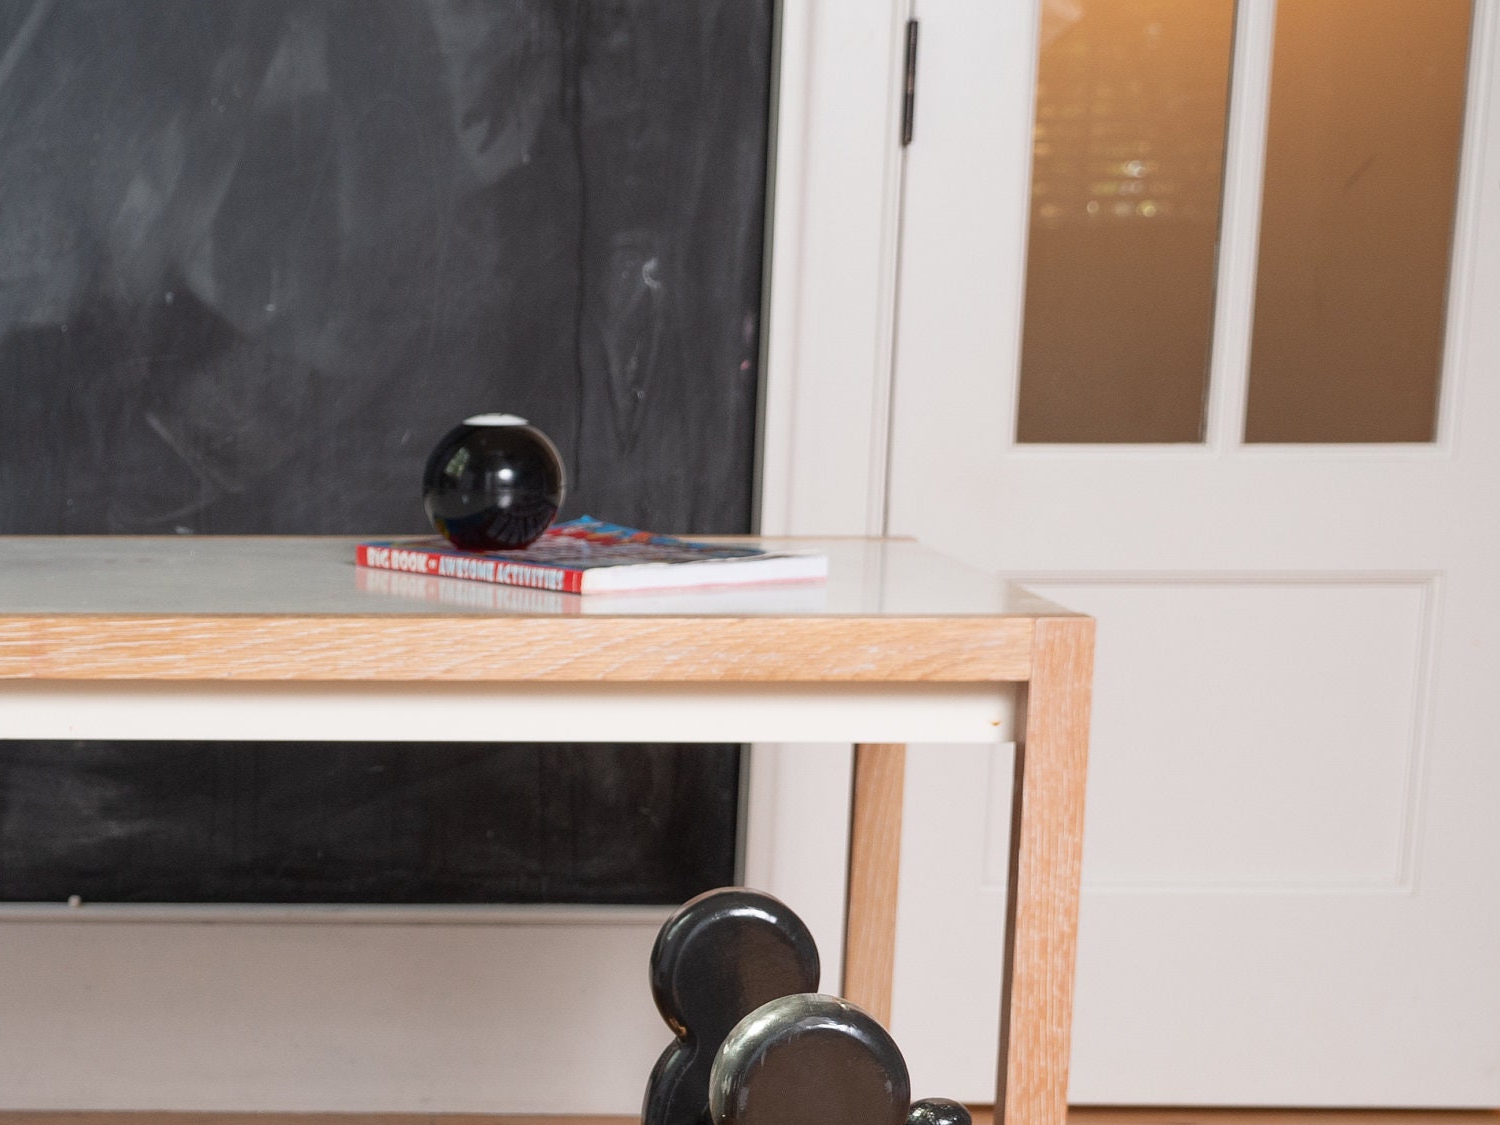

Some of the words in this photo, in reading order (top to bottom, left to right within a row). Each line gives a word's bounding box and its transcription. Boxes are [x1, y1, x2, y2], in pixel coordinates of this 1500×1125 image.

[390, 550, 428, 572] BOOK
[438, 555, 496, 582] AWESOME
[497, 563, 565, 590] ACTIVITIES
